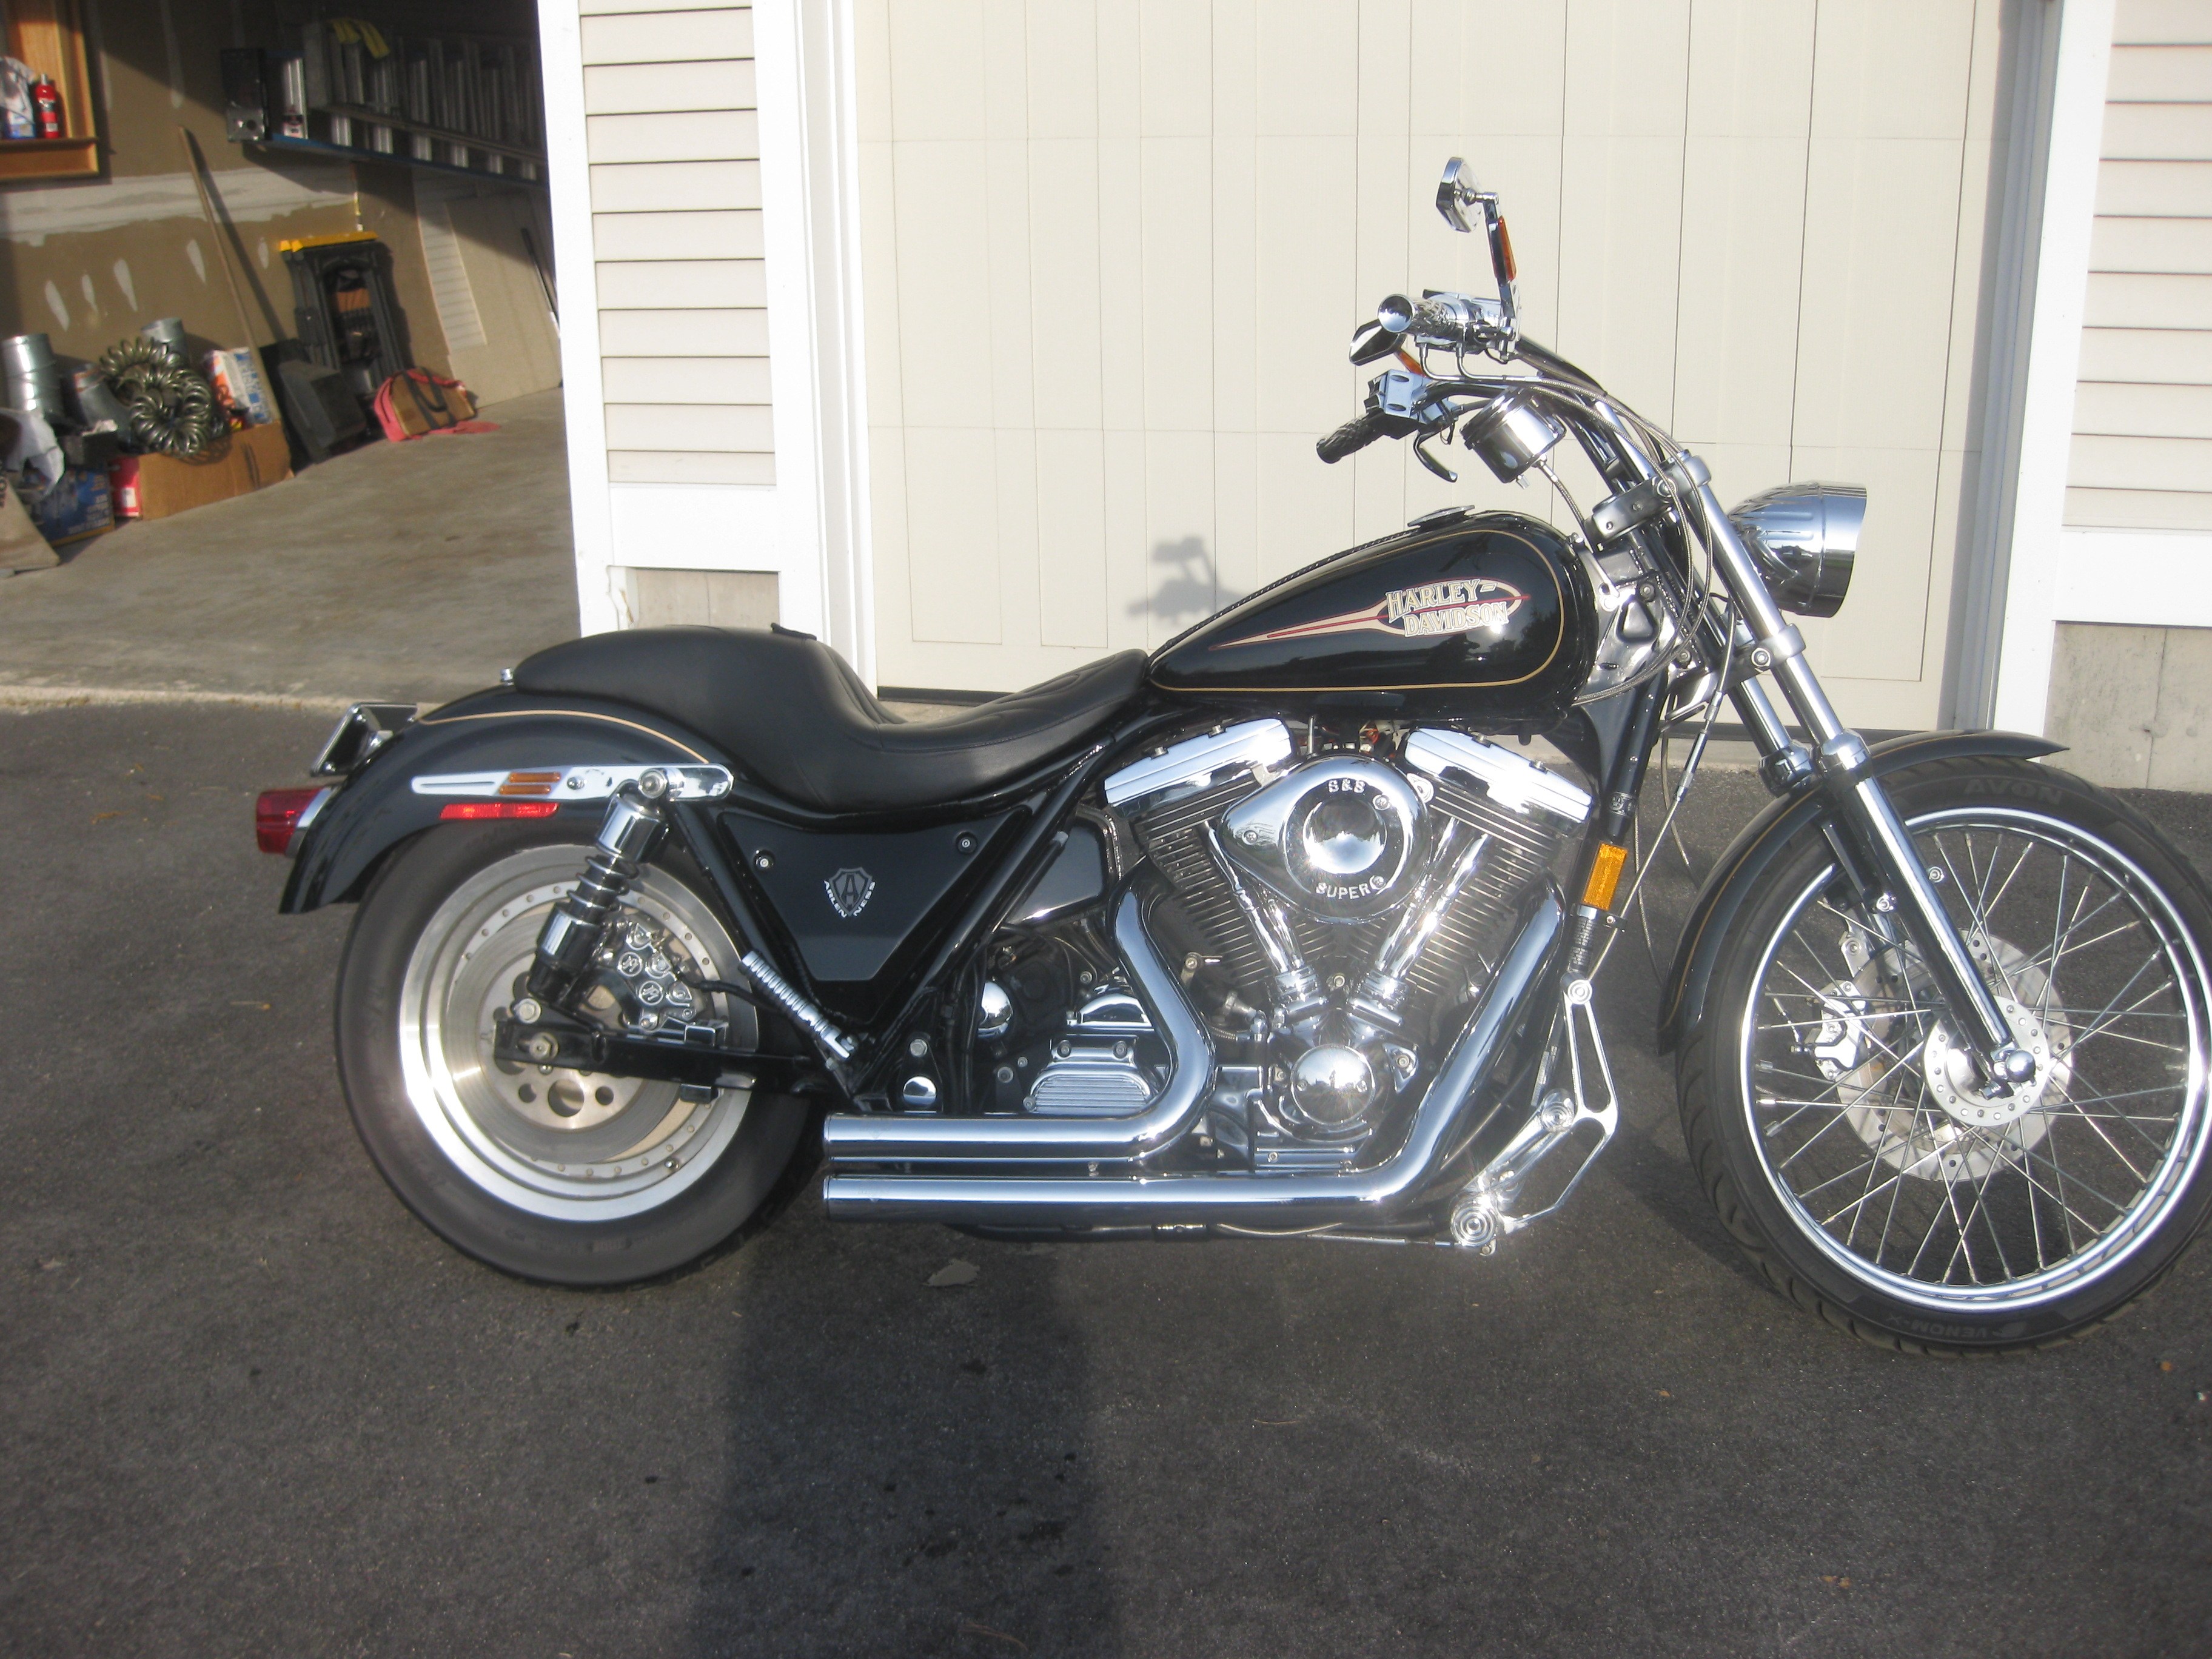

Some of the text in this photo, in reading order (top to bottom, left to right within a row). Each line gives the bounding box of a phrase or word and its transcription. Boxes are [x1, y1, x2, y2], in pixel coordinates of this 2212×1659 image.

[1386, 578, 1498, 623] HARLEY-
[1403, 602, 1509, 637] DAVIDSON
[1328, 778, 1365, 793] S&S
[1964, 779, 2062, 805] AVON
[1316, 882, 1371, 899] SUPER
[1886, 1312, 1987, 1338] VENOM-X
